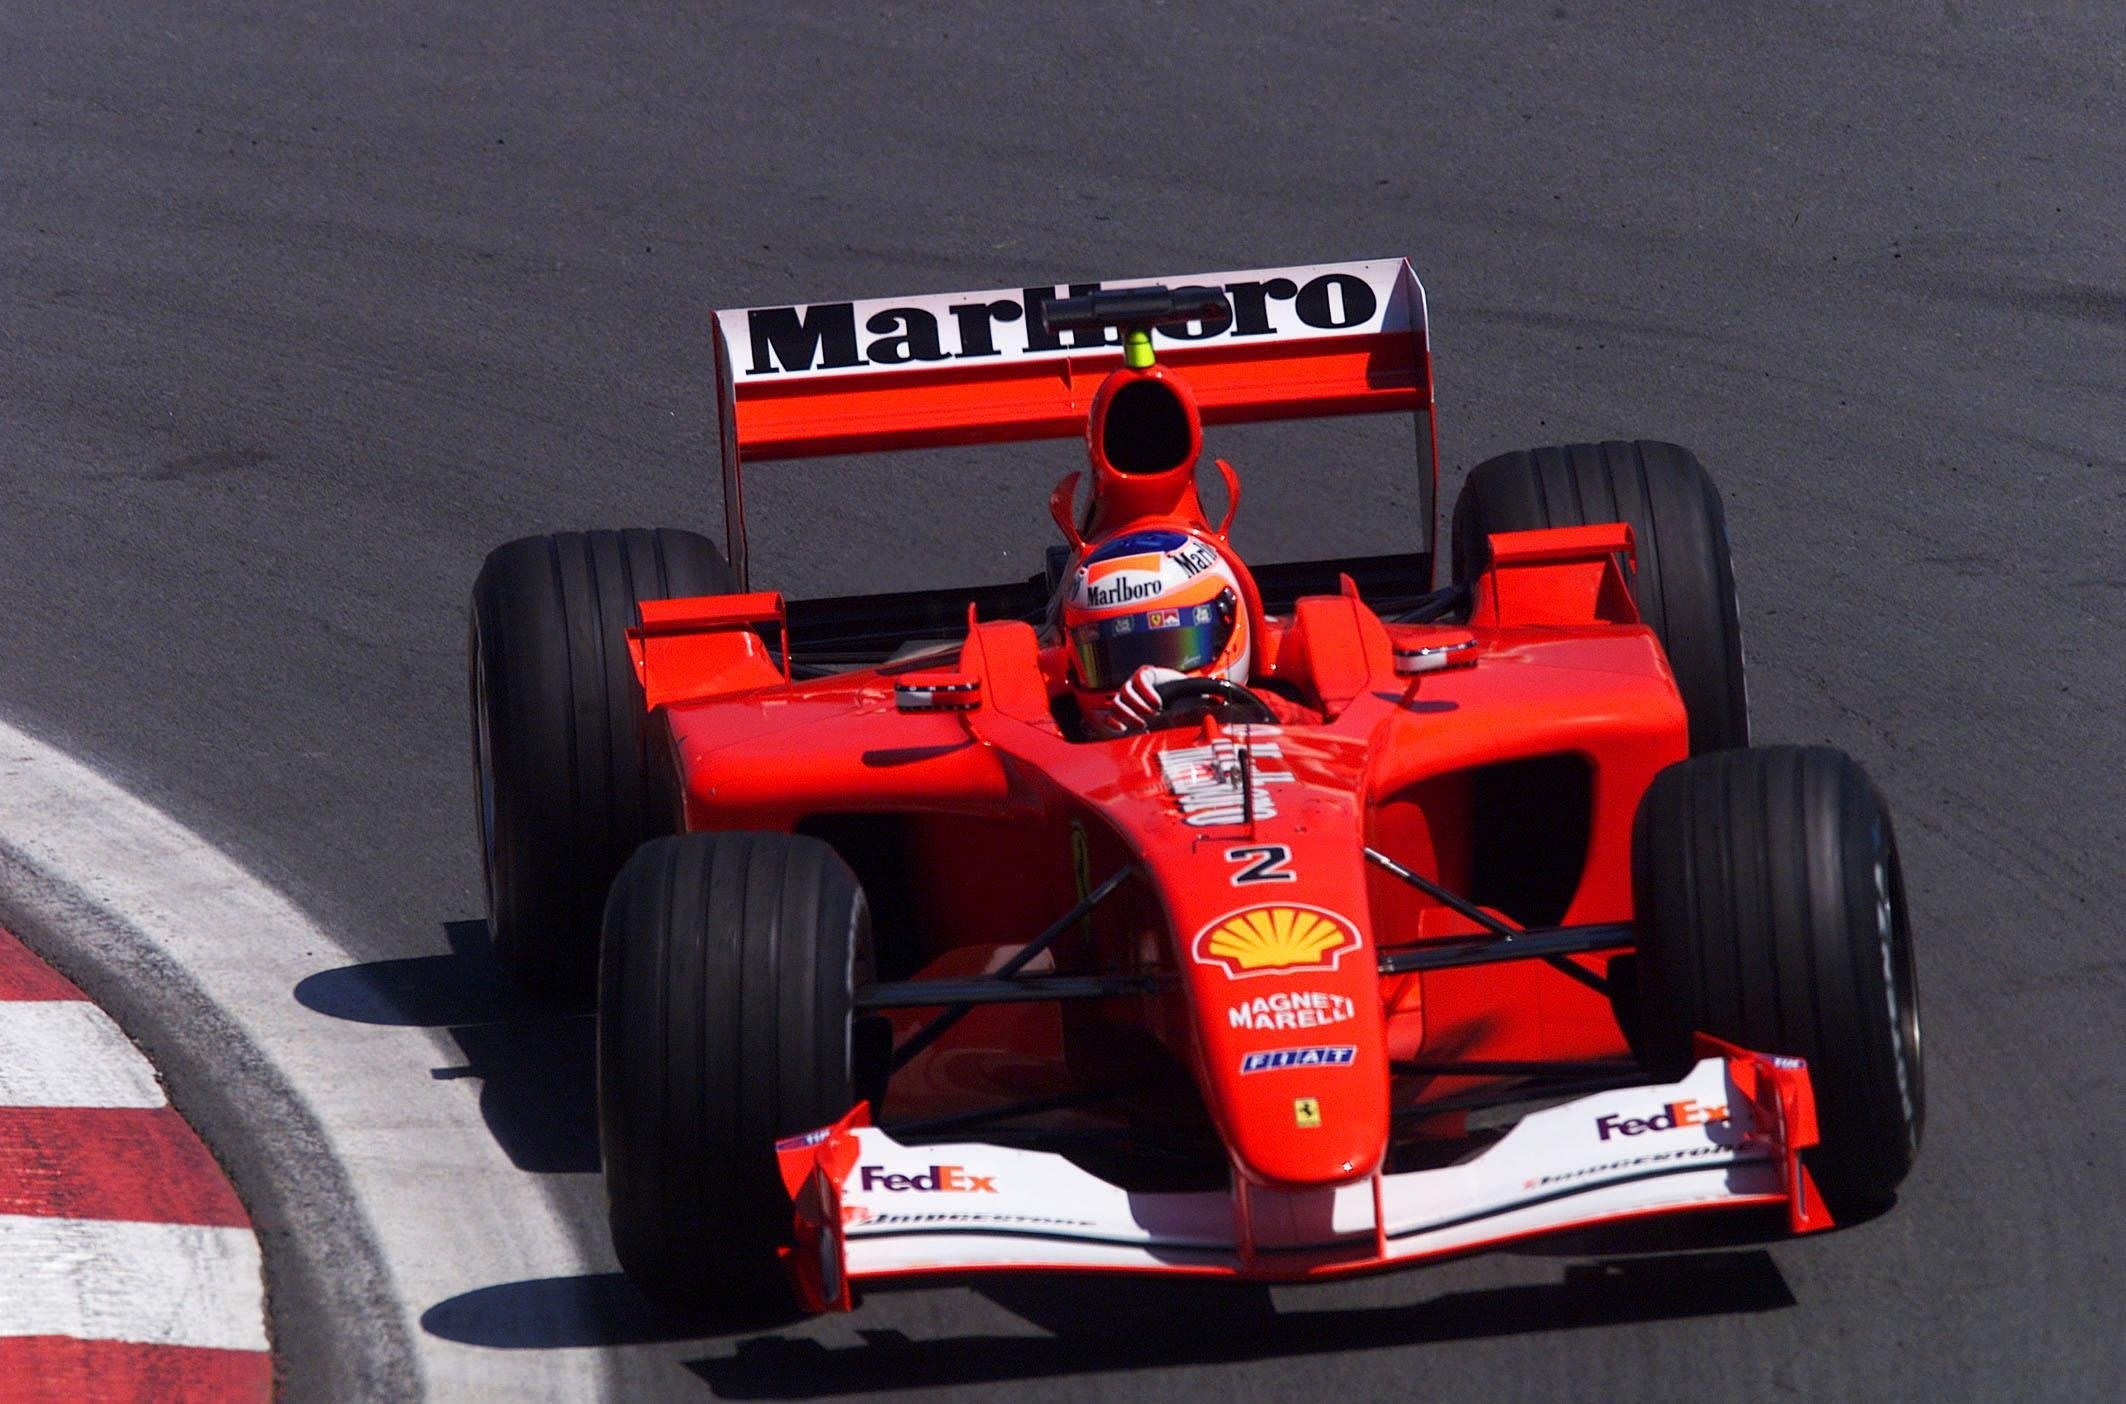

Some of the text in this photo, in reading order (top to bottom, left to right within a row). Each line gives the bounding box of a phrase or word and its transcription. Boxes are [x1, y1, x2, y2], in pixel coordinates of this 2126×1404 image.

[1087, 577, 1162, 607] Marlboro
[1225, 844, 1295, 886] 2
[1229, 991, 1354, 1023] MAGNETI
[1229, 1001, 1354, 1030] MARELLI
[1246, 1049, 1352, 1071] FIAT
[1596, 1099, 1730, 1141] FedEx
[861, 1165, 999, 1193] FedEx
